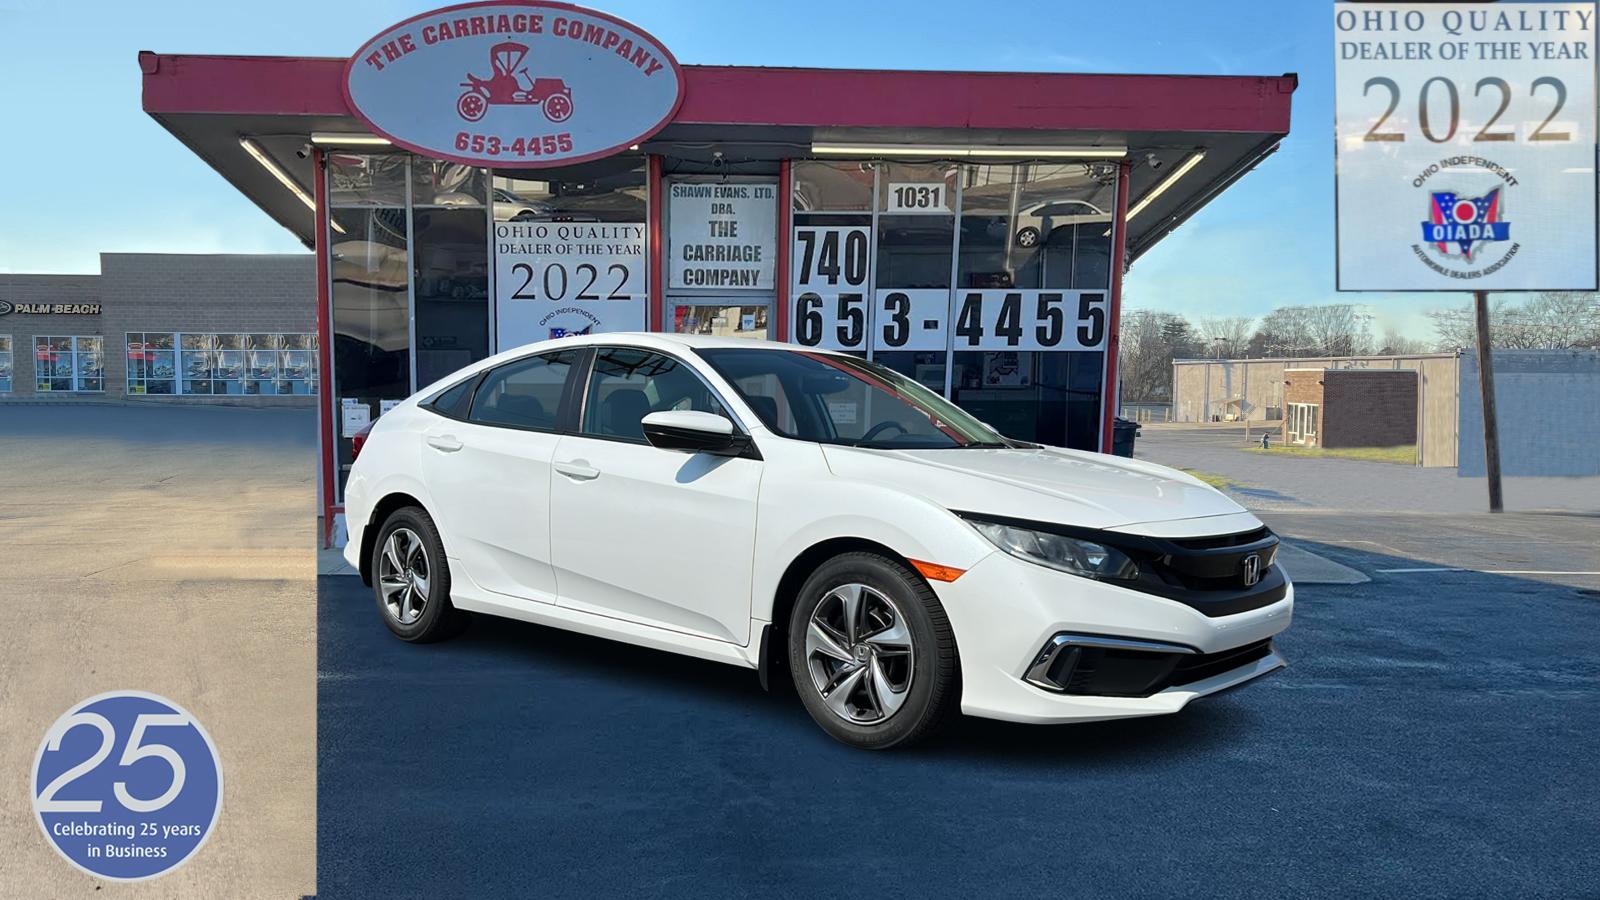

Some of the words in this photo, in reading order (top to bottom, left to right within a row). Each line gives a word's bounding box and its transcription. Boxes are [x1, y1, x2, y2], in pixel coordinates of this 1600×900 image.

[1336, 10, 1425, 31] OHIO
[1442, 10, 1592, 35] QUALITY
[365, 33, 417, 72] THE
[422, 14, 544, 46] CARRIAGE
[552, 16, 664, 78] COMPANY
[1340, 42, 1433, 60] DEALER
[1439, 42, 1469, 60] OF
[1475, 42, 1522, 60] THE
[1528, 41, 1589, 59] YEAR
[1363, 76, 1571, 143] 2022
[455, 131, 573, 157] 653-4455
[1413, 164, 1439, 188] OHIO
[1440, 155, 1519, 187] INDEPENDENT
[672, 185, 712, 199] SHAWN
[754, 187, 775, 199] LTD.
[894, 186, 941, 209] 1031
[711, 203, 735, 215] DBA.
[497, 226, 548, 239] OHIO
[558, 226, 644, 241] QUALITY
[708, 220, 738, 238] THE
[1433, 224, 1495, 240] OIADA
[499, 243, 552, 255] DEALER
[555, 243, 573, 255] OF
[576, 243, 603, 255] THE
[605, 243, 642, 255] YEAR
[683, 244, 762, 262] CARRIAGE
[797, 230, 868, 287] 740
[511, 263, 632, 301] 2022
[683, 268, 760, 286] COMPANY
[1450, 270, 1482, 280] DEALERS
[15, 303, 51, 314] PALM
[54, 303, 100, 314] BEACH
